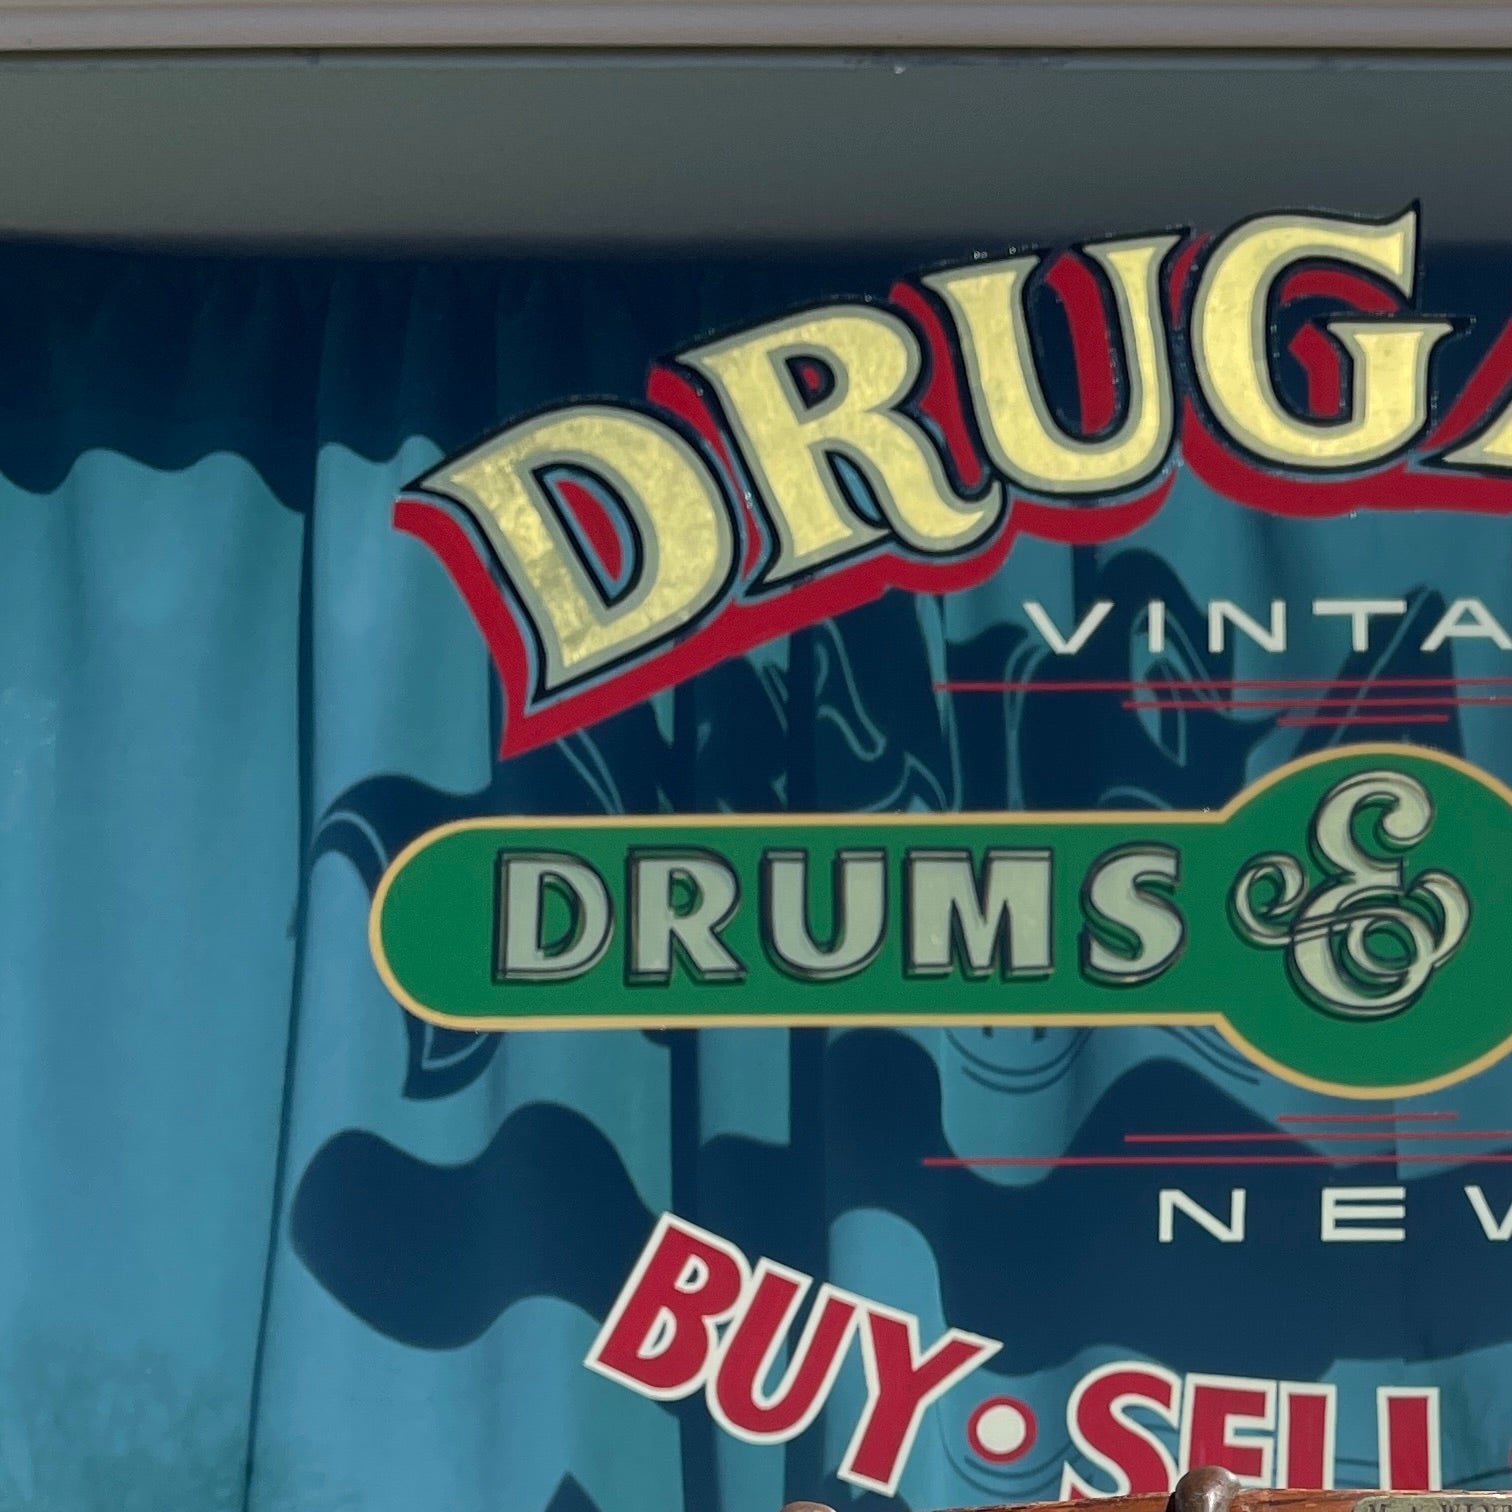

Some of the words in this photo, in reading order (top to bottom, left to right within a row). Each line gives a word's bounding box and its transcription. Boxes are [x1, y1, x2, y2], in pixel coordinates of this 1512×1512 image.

[493, 843, 1188, 988] DRUMS
[1229, 770, 1472, 1020] &
[583, 1211, 1004, 1498] BUY
